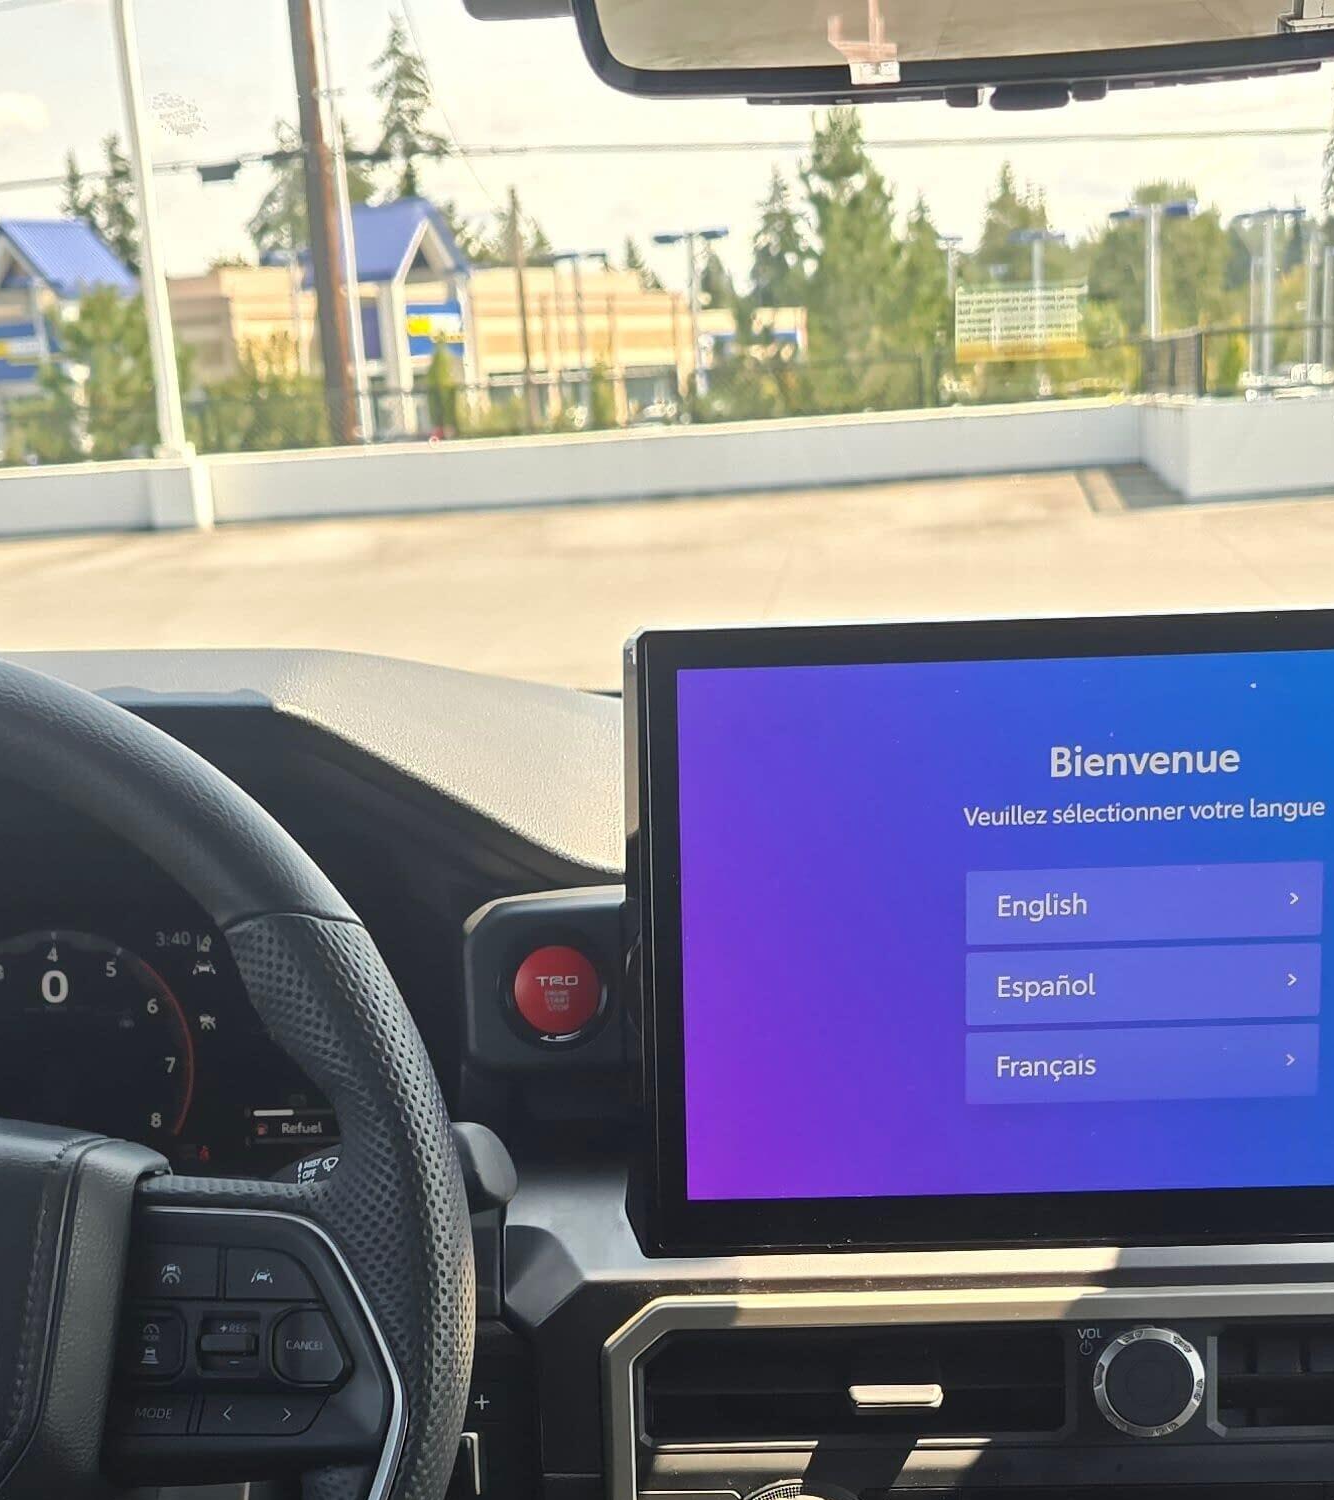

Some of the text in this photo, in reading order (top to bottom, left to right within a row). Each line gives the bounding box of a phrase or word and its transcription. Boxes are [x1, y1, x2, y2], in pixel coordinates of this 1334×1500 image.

[1049, 746, 1241, 778] Bienvenue
[963, 798, 1326, 827] Veuillez sélectionner votre langue
[997, 892, 1088, 922] English
[46, 946, 59, 962] 4
[105, 961, 117, 978] 5
[41, 970, 69, 1004] 0
[535, 975, 579, 988] TRD
[997, 972, 1097, 1003] Español
[146, 998, 159, 1015] 6
[164, 1056, 176, 1074] 7
[996, 1053, 1097, 1082] Français
[150, 1112, 162, 1129] 8
[280, 1121, 323, 1135] Refuel
[1077, 1328, 1102, 1340] VOL
[285, 1339, 323, 1351] CANCEL
[134, 1406, 172, 1420] MODE
